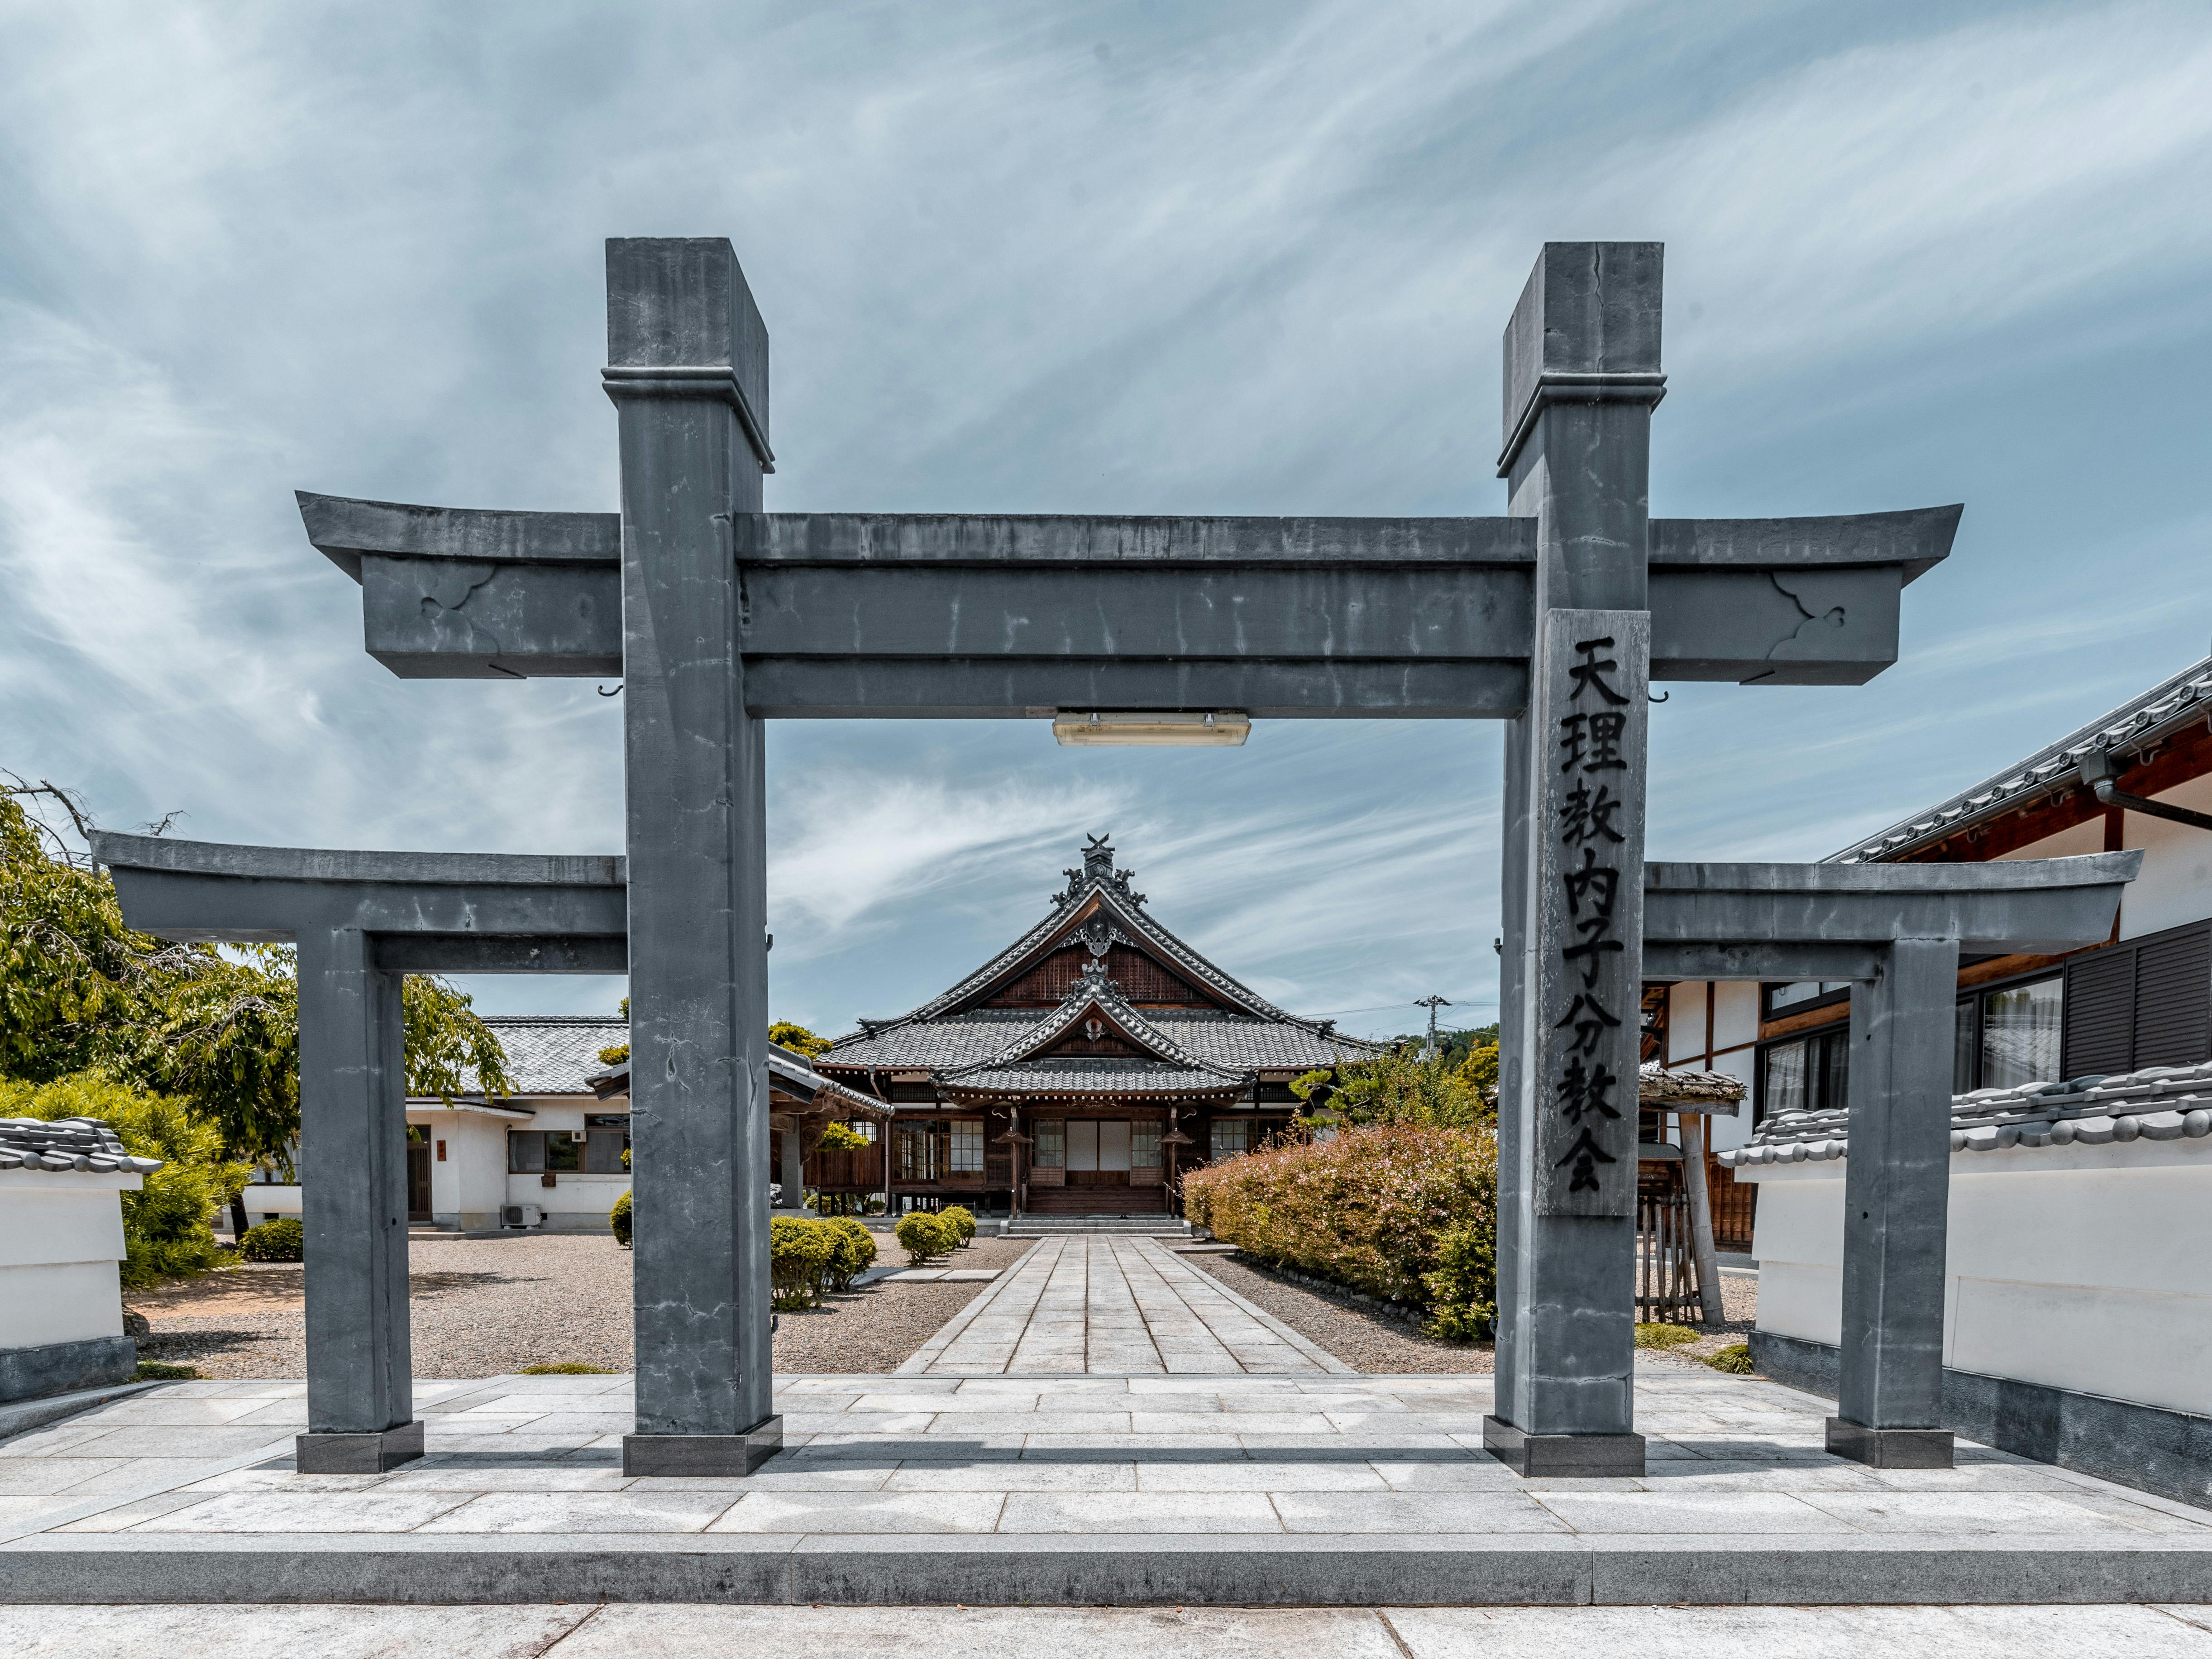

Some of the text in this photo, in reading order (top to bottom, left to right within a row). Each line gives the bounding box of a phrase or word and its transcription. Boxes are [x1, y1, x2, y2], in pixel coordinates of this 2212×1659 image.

[1554, 636, 1630, 1192] 天理教内子分教会
